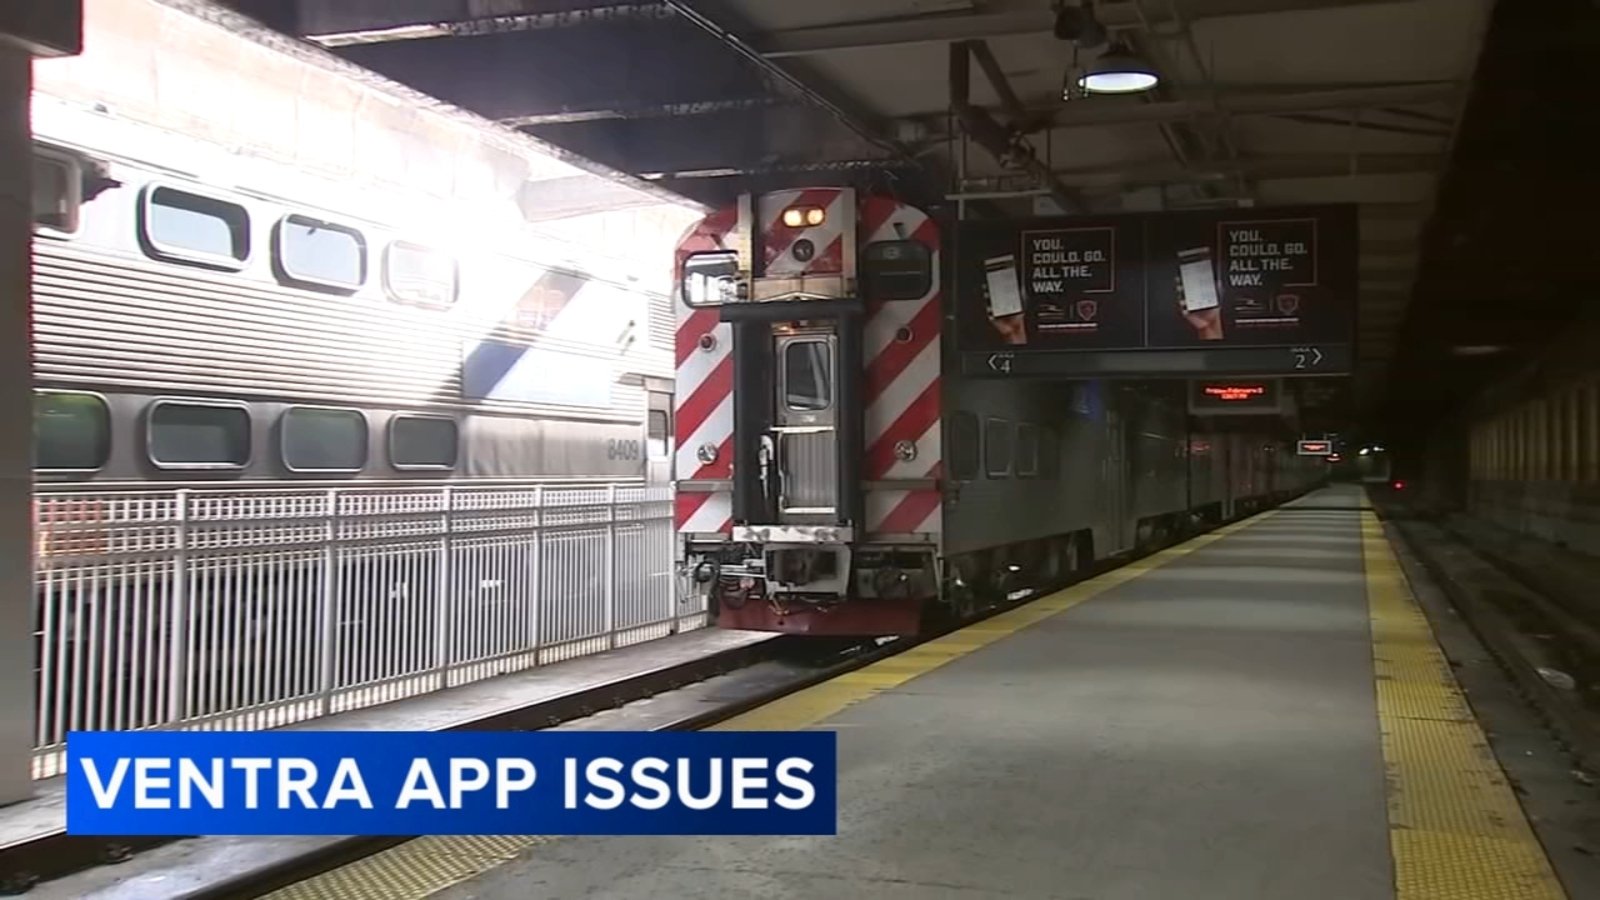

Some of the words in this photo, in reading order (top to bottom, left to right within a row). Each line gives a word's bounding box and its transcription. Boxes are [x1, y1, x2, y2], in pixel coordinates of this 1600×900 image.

[1228, 229, 1263, 242] YOU.
[1032, 239, 1064, 251] YOU.
[1229, 243, 1281, 257] COULD.
[1284, 242, 1307, 255] GO.
[1033, 251, 1080, 264] COULD.
[1084, 250, 1106, 262] GO.
[1260, 258, 1293, 270] THE.
[1061, 265, 1092, 278] THE.
[1229, 273, 1263, 286] WAY.
[1032, 280, 1064, 293] WAY.
[1000, 359, 1011, 374] 4
[1295, 354, 1306, 369] 2
[608, 438, 639, 461] 8409
